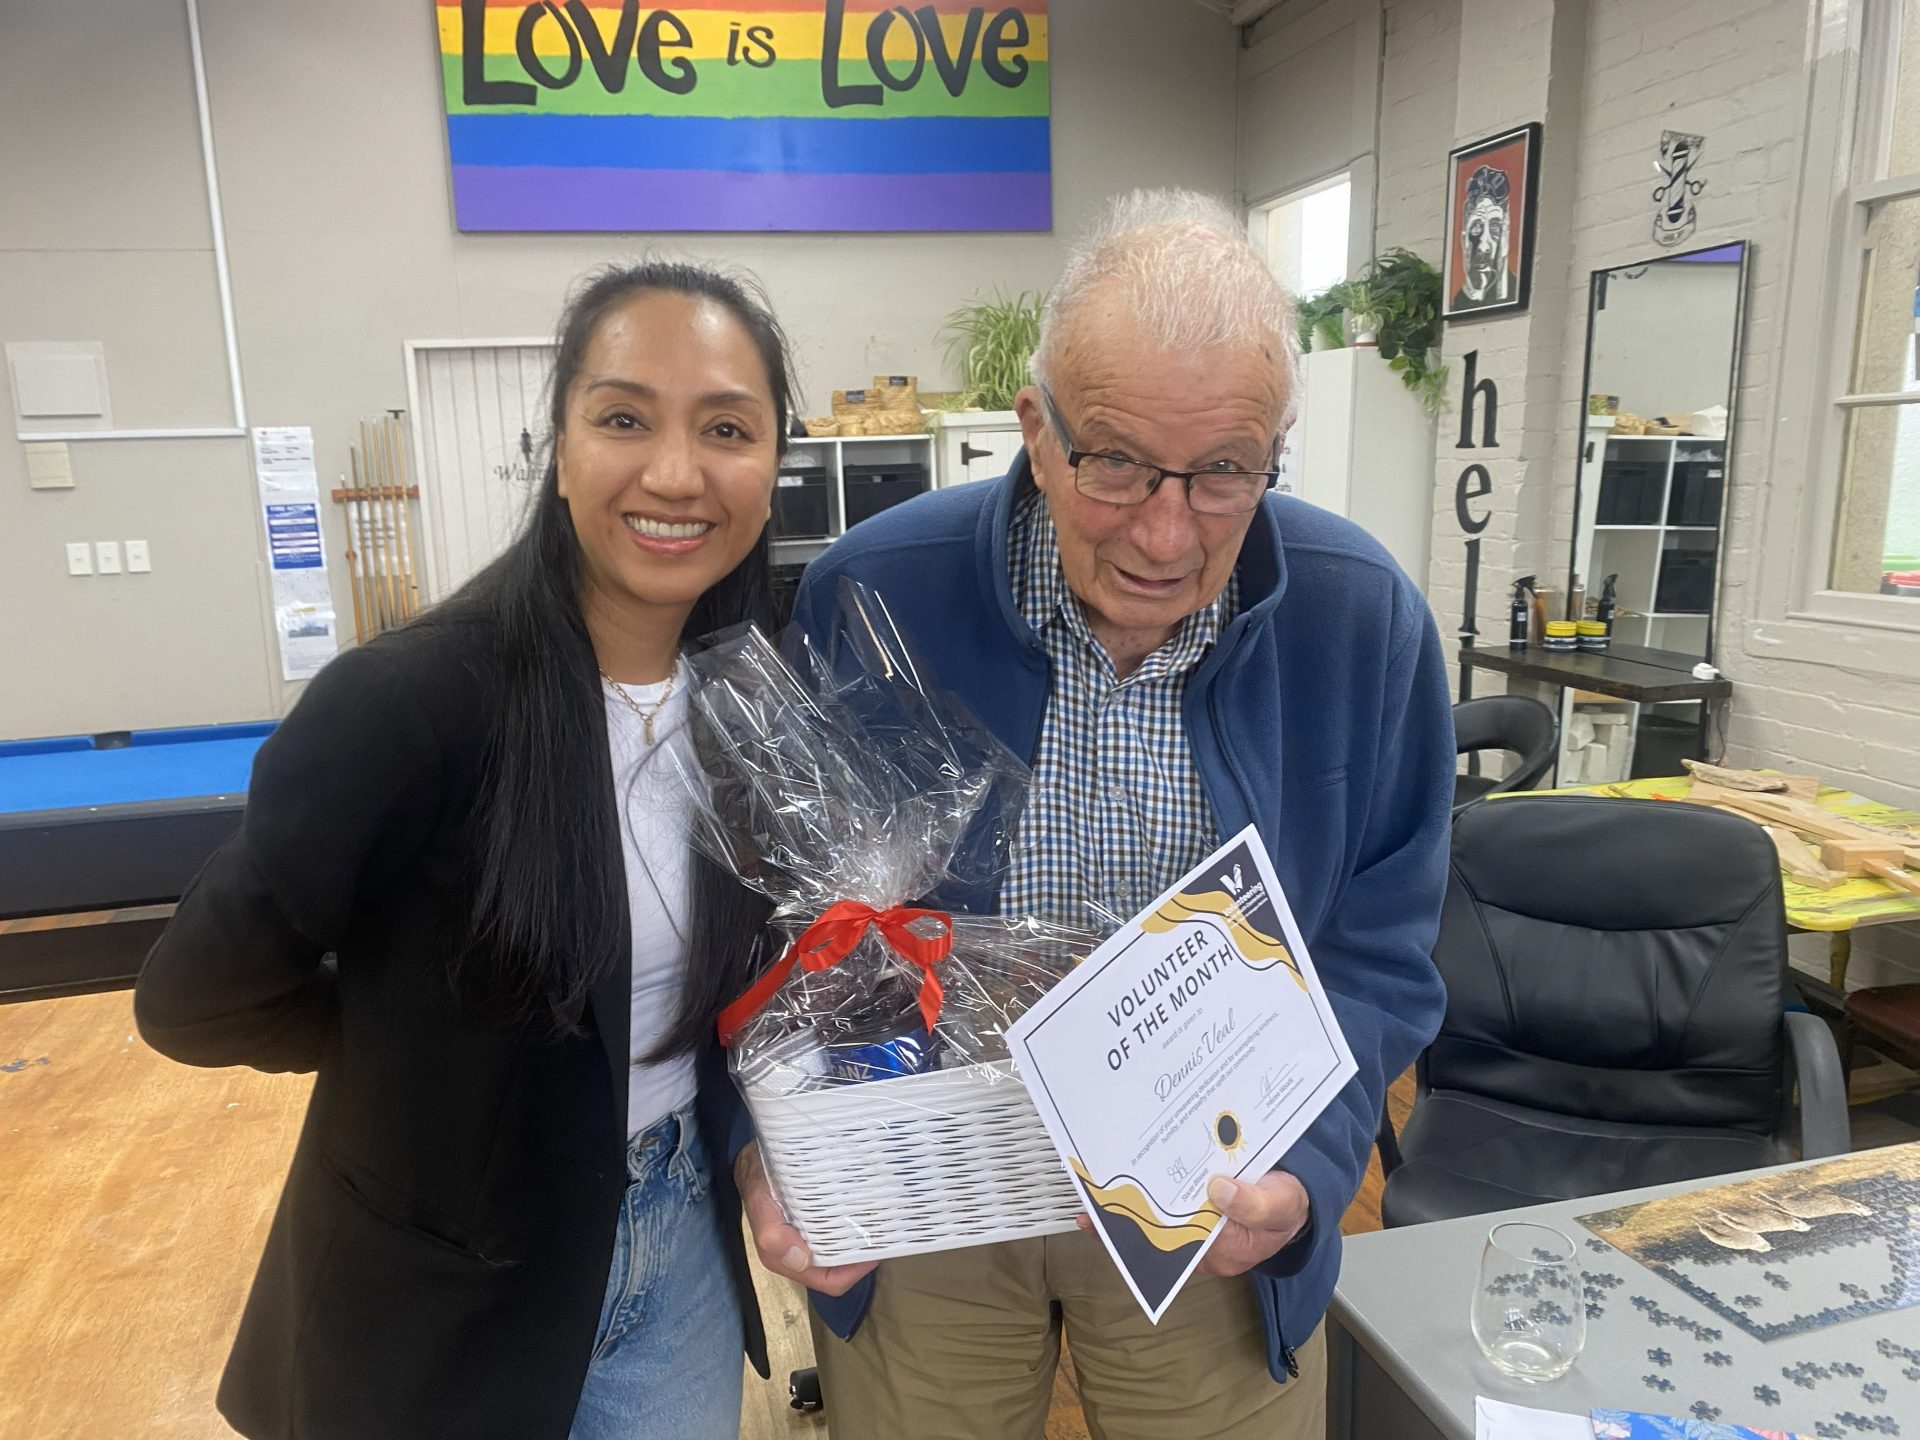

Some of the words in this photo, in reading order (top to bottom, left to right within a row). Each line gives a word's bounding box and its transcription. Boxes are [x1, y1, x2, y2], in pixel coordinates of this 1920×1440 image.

[726, 22, 776, 68] is
[1107, 930, 1208, 1027] VOLUNTEER
[1107, 1037, 1130, 1071] OF
[1132, 1003, 1169, 1044] THE
[1169, 943, 1233, 1012] MONTH
[1154, 1046, 1203, 1102] Dennis
[1201, 1007, 1235, 1054] Veal
